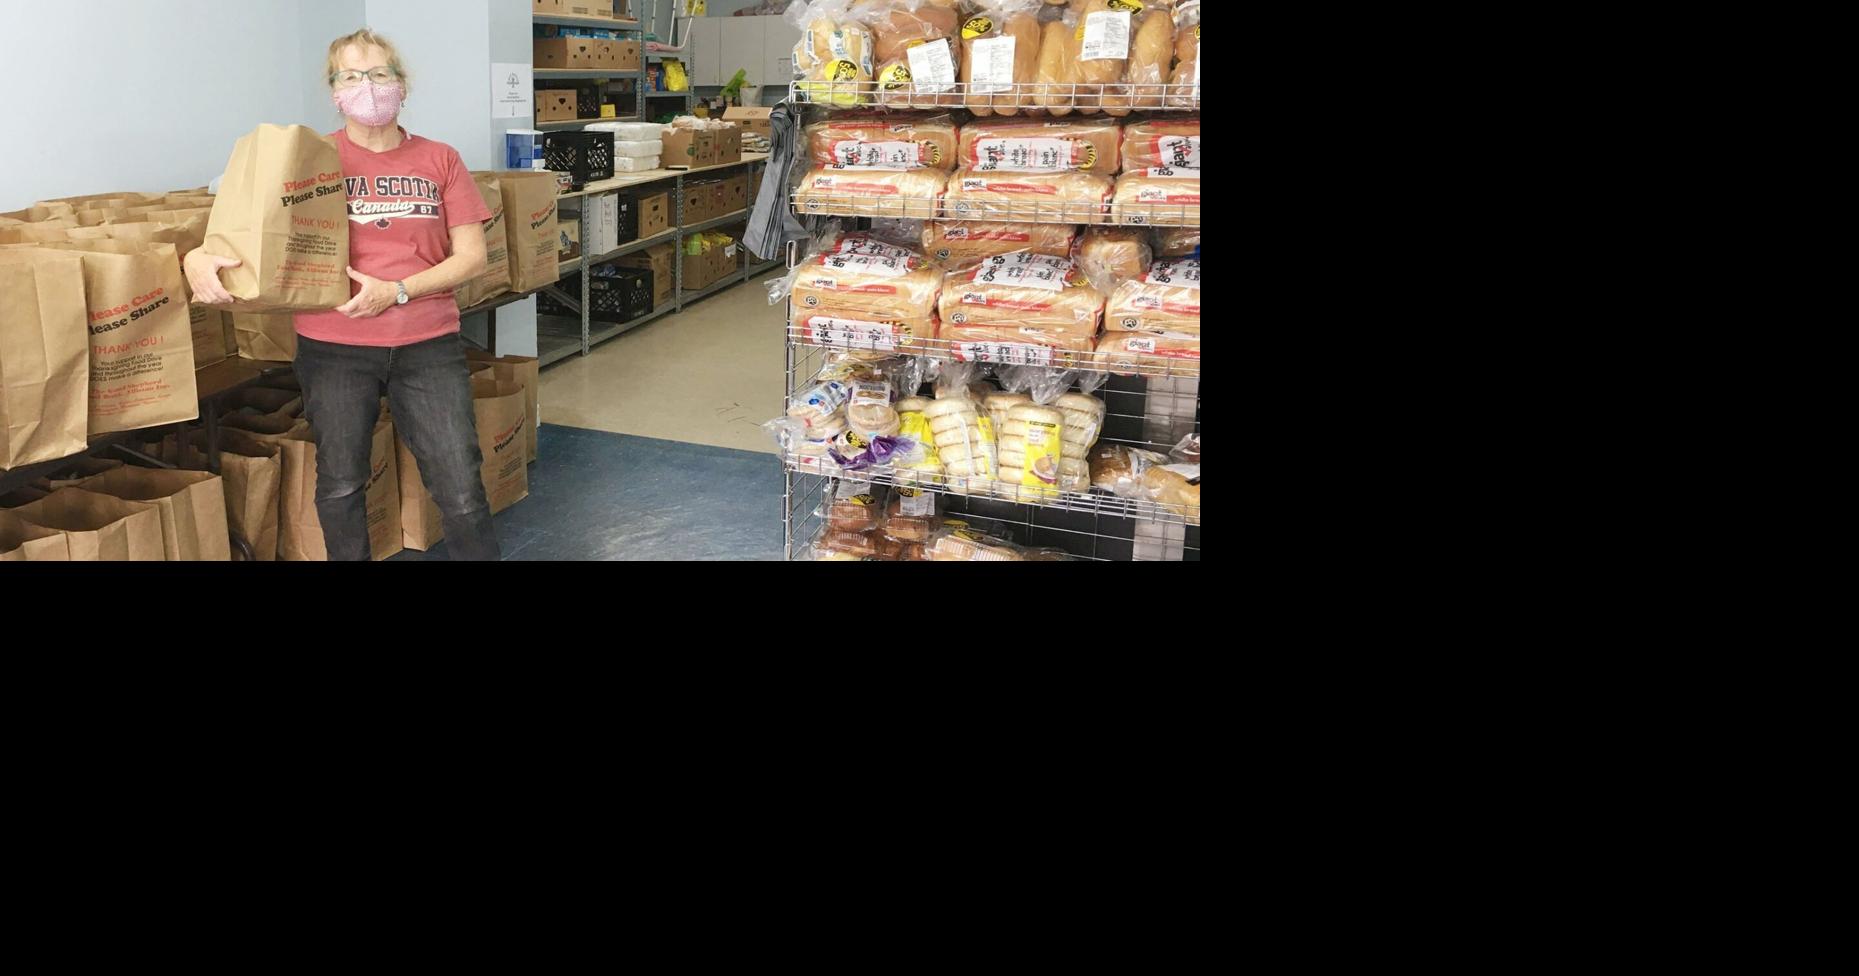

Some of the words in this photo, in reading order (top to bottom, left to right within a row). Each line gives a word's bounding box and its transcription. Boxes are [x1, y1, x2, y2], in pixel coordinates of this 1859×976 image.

[283, 177, 316, 192] Please
[318, 171, 341, 183] Care
[344, 176, 370, 197] VA
[281, 192, 314, 207] Please
[351, 198, 411, 215] Canada
[291, 215, 314, 227] THANK
[317, 218, 335, 229] YOU
[90, 303, 130, 321] lease
[131, 287, 164, 307] Care
[88, 318, 128, 336] lease
[129, 296, 169, 321] Share
[93, 342, 131, 355] THANK
[134, 336, 157, 349] YOU
